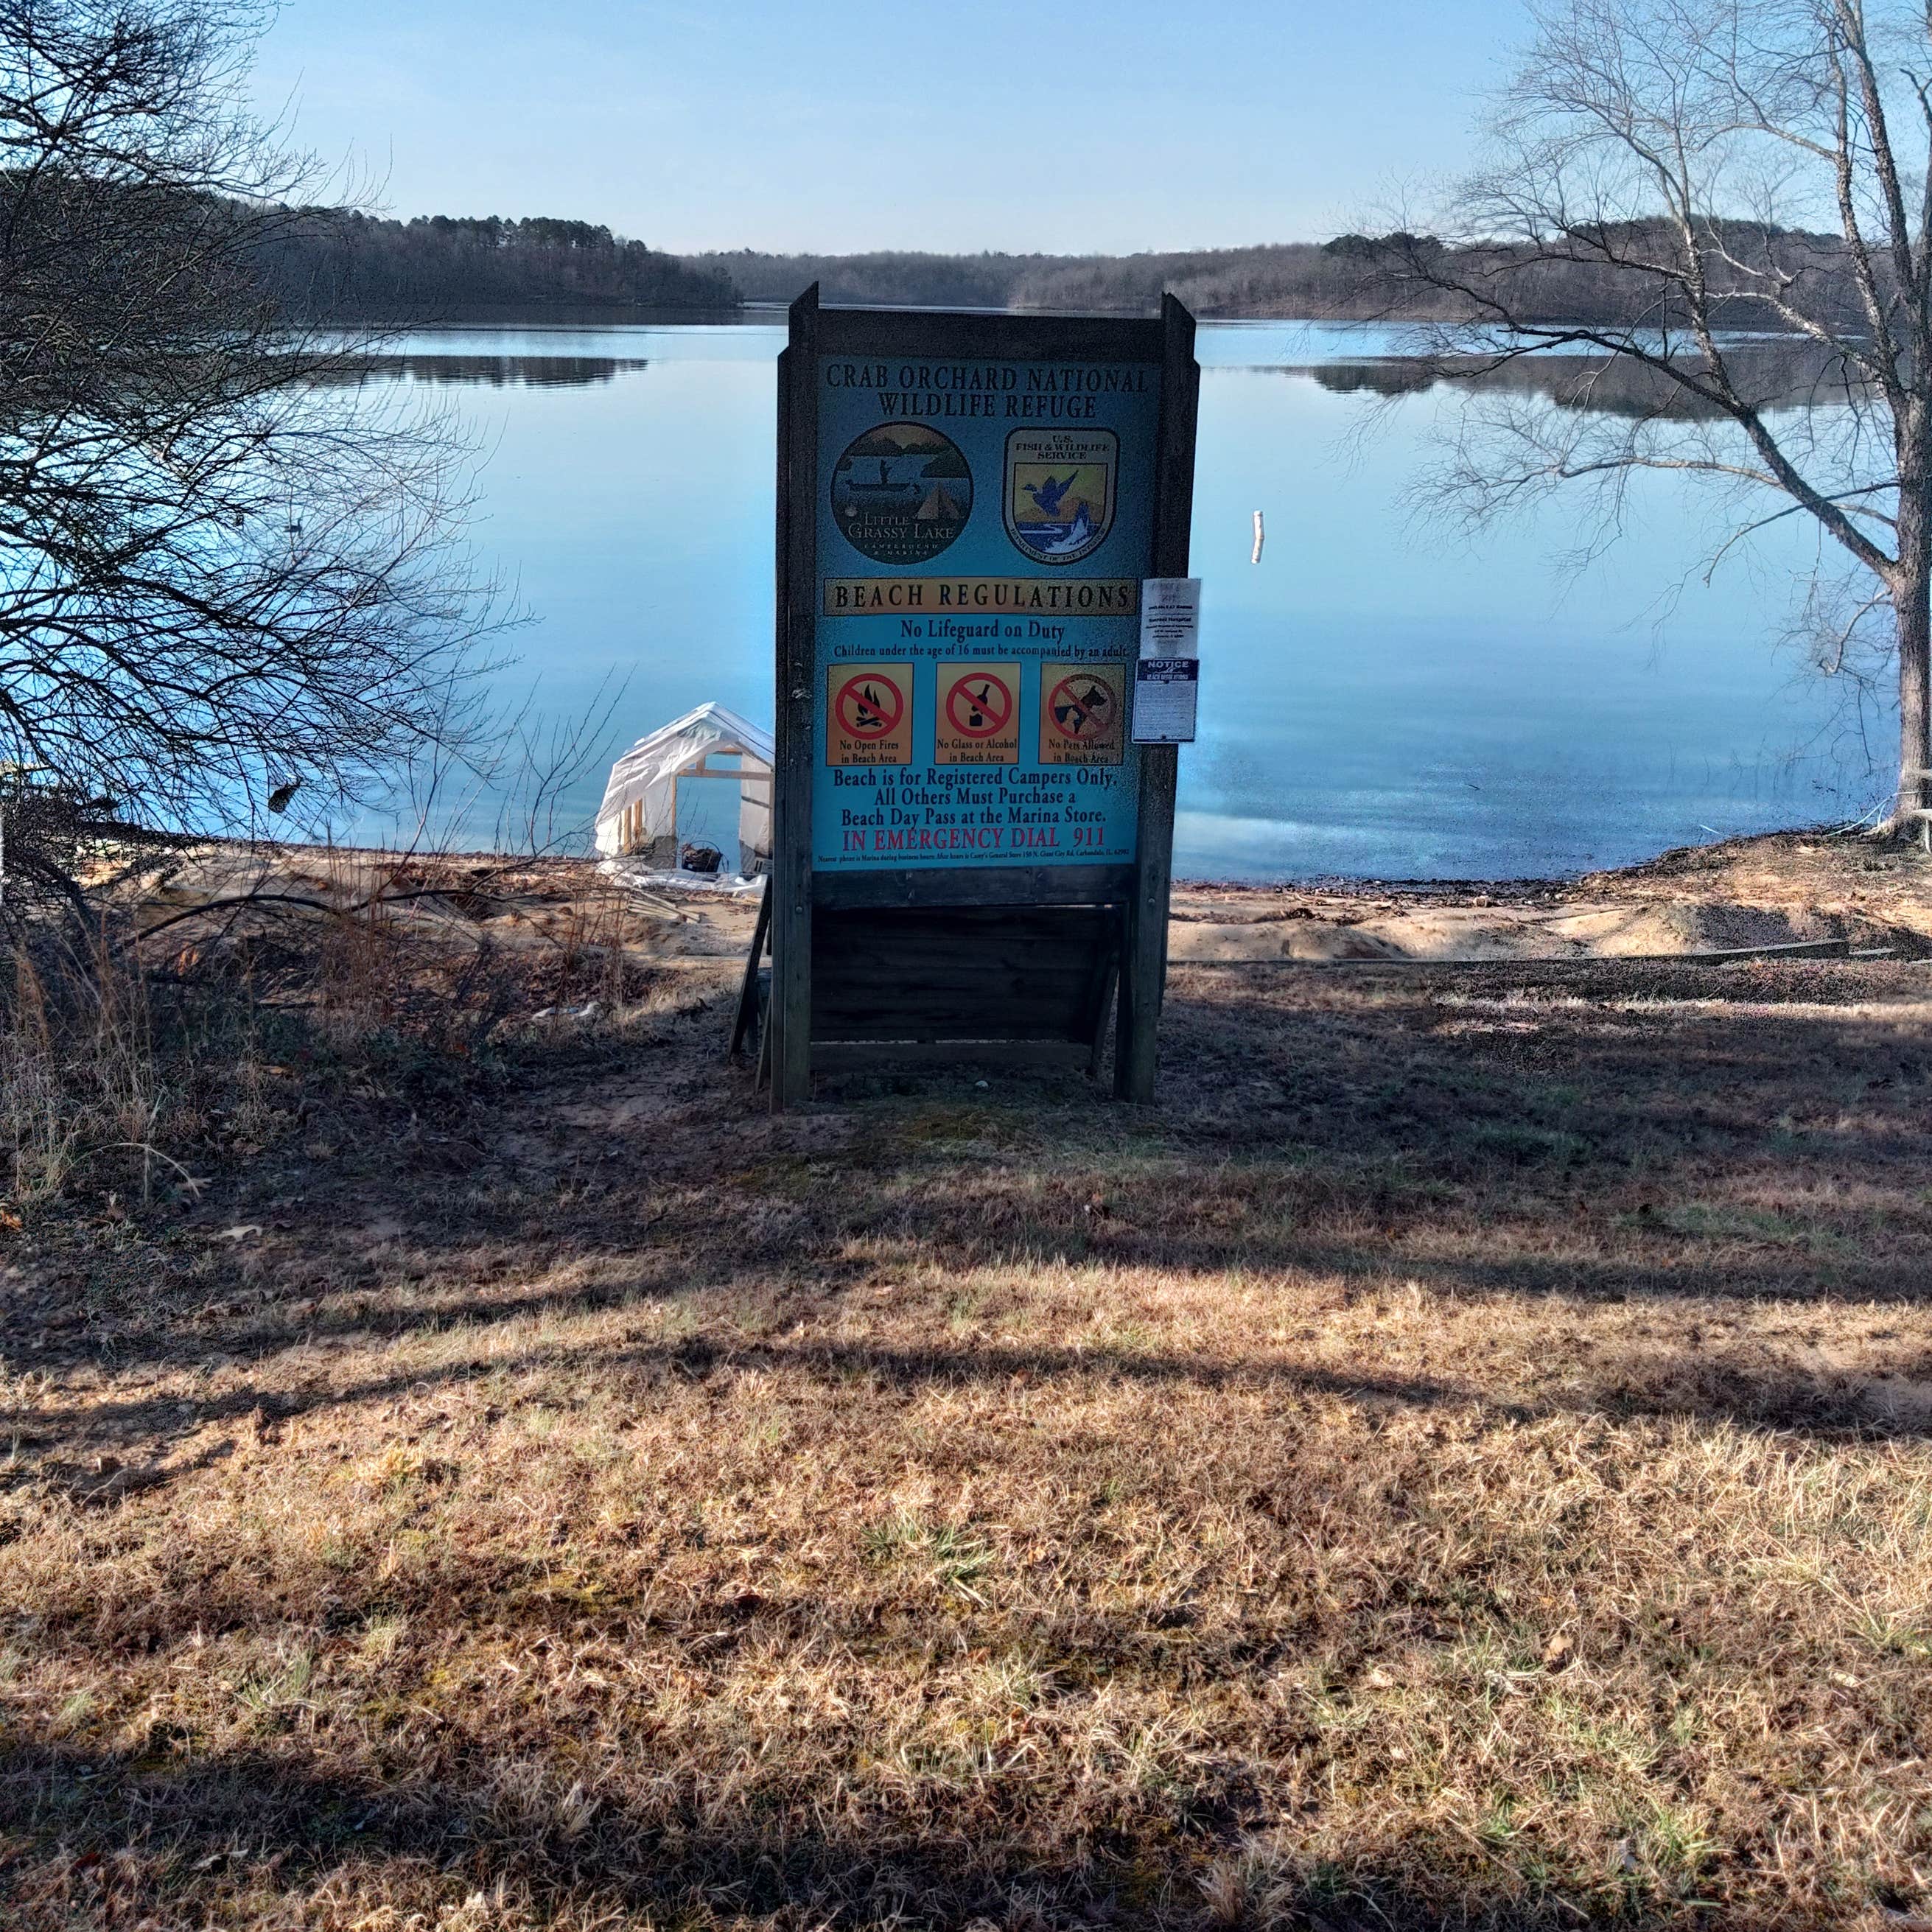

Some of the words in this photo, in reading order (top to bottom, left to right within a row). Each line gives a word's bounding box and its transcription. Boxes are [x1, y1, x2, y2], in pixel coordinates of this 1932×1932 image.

[827, 364, 888, 388] CRAB
[898, 365, 1017, 391] ORCHARD
[1026, 368, 1149, 393] NATIONAL
[878, 392, 995, 417] WILDLIFE
[1004, 394, 1097, 419] REFUGE
[1052, 435, 1074, 444] U.S.
[1016, 443, 1041, 451] FISH
[1054, 443, 1110, 452] WILDLIFE
[1037, 452, 1087, 460] SERVICE
[834, 584, 923, 608] BEACH
[938, 584, 1128, 608] REGULATIONS
[900, 620, 922, 638] No
[927, 619, 998, 643] Lifeguard
[1004, 625, 1023, 638] on
[1027, 620, 1065, 644] Duty
[833, 644, 875, 657] Children
[878, 644, 907, 656] under
[909, 644, 925, 656] the
[926, 647, 942, 659] age
[945, 643, 956, 656] of
[958, 644, 970, 656] 16
[972, 645, 997, 656] must
[998, 644, 1009, 656] be
[1010, 644, 1071, 659] accompanied
[1074, 645, 1085, 659] by
[1088, 648, 1099, 657] an
[1147, 660, 1190, 669] NOTICE
[839, 739, 852, 750] No
[854, 739, 877, 753] Open
[879, 738, 899, 750] Fires
[937, 738, 949, 749] No
[951, 738, 973, 749] Glass
[974, 741, 984, 749] or
[986, 738, 1017, 749] Alcohol
[1048, 738, 1060, 749] No
[1063, 738, 1081, 750] Pets
[1081, 738, 1115, 750] Allowed
[841, 753, 850, 764] in
[853, 752, 876, 763] Beach
[878, 753, 897, 763] Area
[949, 752, 957, 763] in
[959, 752, 983, 763] Beach
[984, 752, 1004, 763] Area
[1053, 752, 1062, 763] in
[1064, 752, 1088, 763] Beach
[1090, 752, 1109, 763] Area
[833, 768, 877, 787] Beach
[881, 769, 895, 786] is
[899, 766, 922, 785] for
[925, 767, 1002, 791] Registered
[1007, 766, 1071, 790] Campers
[875, 787, 895, 805] All
[901, 787, 951, 805] Others
[956, 787, 994, 805] Must
[998, 786, 1063, 805] Purchase
[1068, 792, 1077, 804] a
[841, 807, 885, 826] Beach
[889, 807, 920, 830] Day
[925, 807, 956, 826] Pass
[960, 810, 975, 825] at
[980, 806, 1004, 825] the
[1007, 806, 1060, 824] Marina
[1063, 805, 1107, 823] Store.
[842, 830, 867, 852] IN
[873, 827, 1004, 851] EMERGENCY
[1010, 827, 1061, 848] DIAL
[1073, 826, 1105, 848] 911
[817, 854, 837, 862] Nearest
[840, 854, 855, 864] phone
[861, 853, 879, 861] Marina
[880, 853, 897, 863] during
[898, 853, 919, 861] business
[989, 850, 1008, 858] General
[1009, 850, 1021, 858] Store
